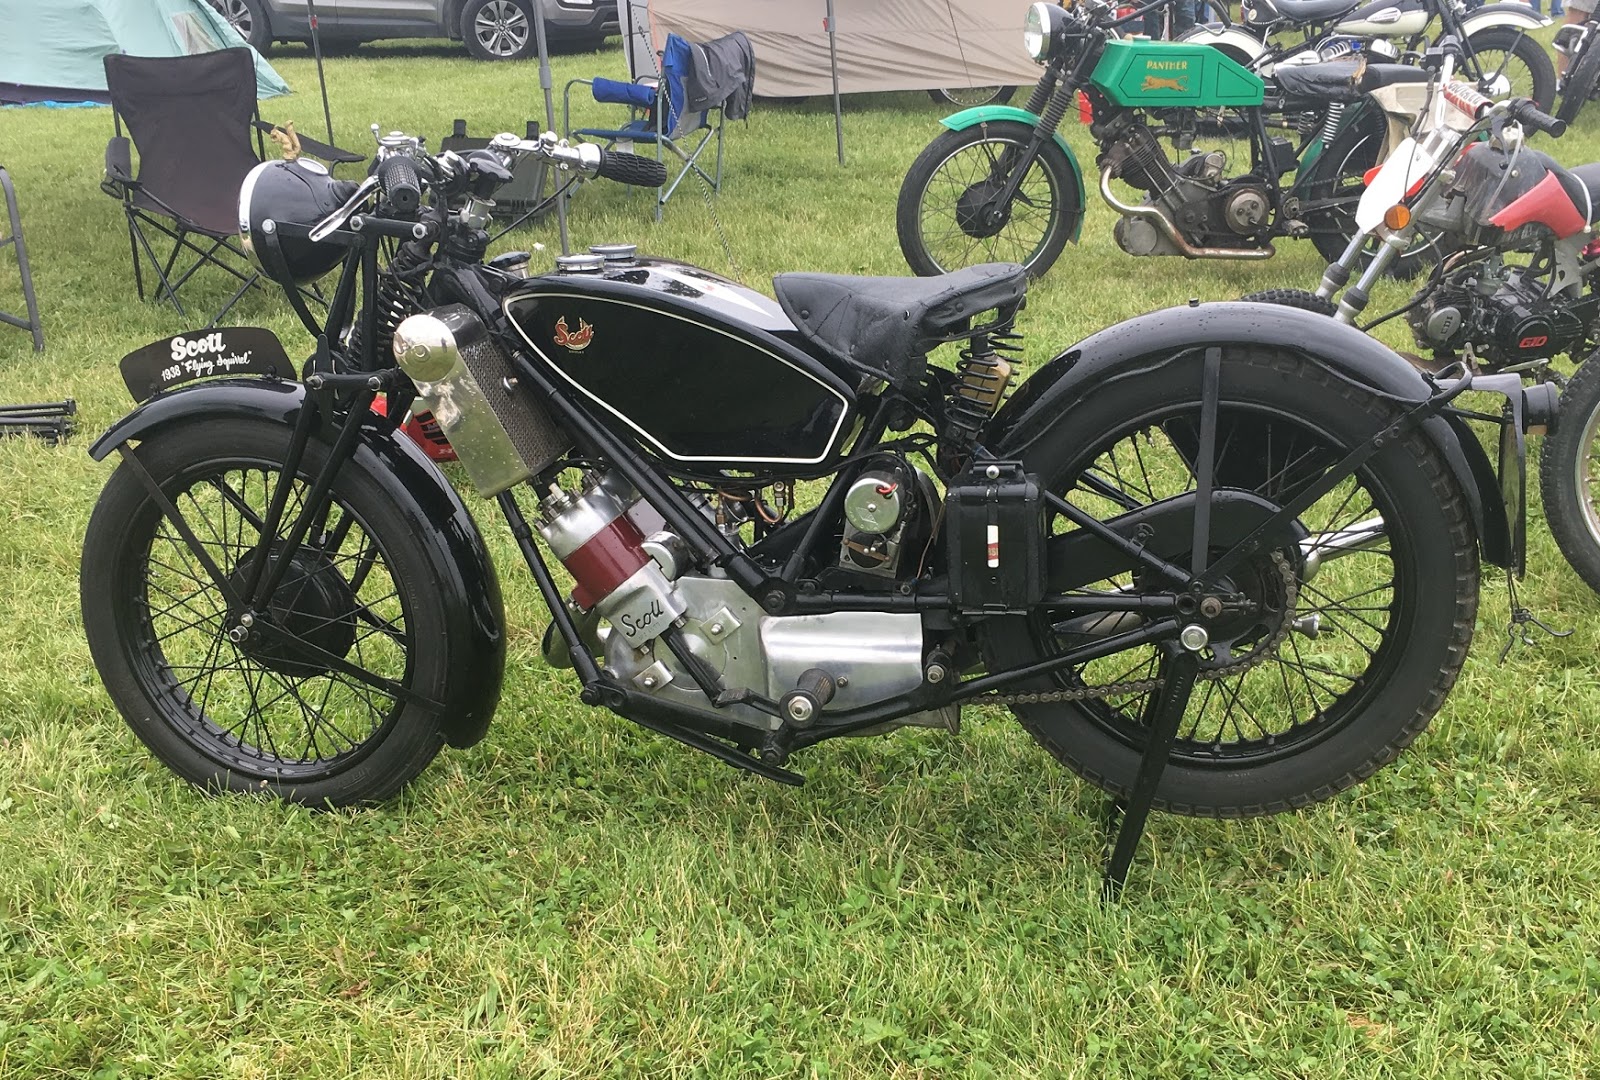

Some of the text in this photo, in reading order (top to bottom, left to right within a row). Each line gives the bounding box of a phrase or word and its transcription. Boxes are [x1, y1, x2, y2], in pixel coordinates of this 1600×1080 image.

[1146, 60, 1188, 70] PANTHER
[553, 321, 595, 346] Scott
[170, 332, 227, 361] Scott
[161, 364, 182, 382] 1938
[621, 599, 665, 638] Scott
